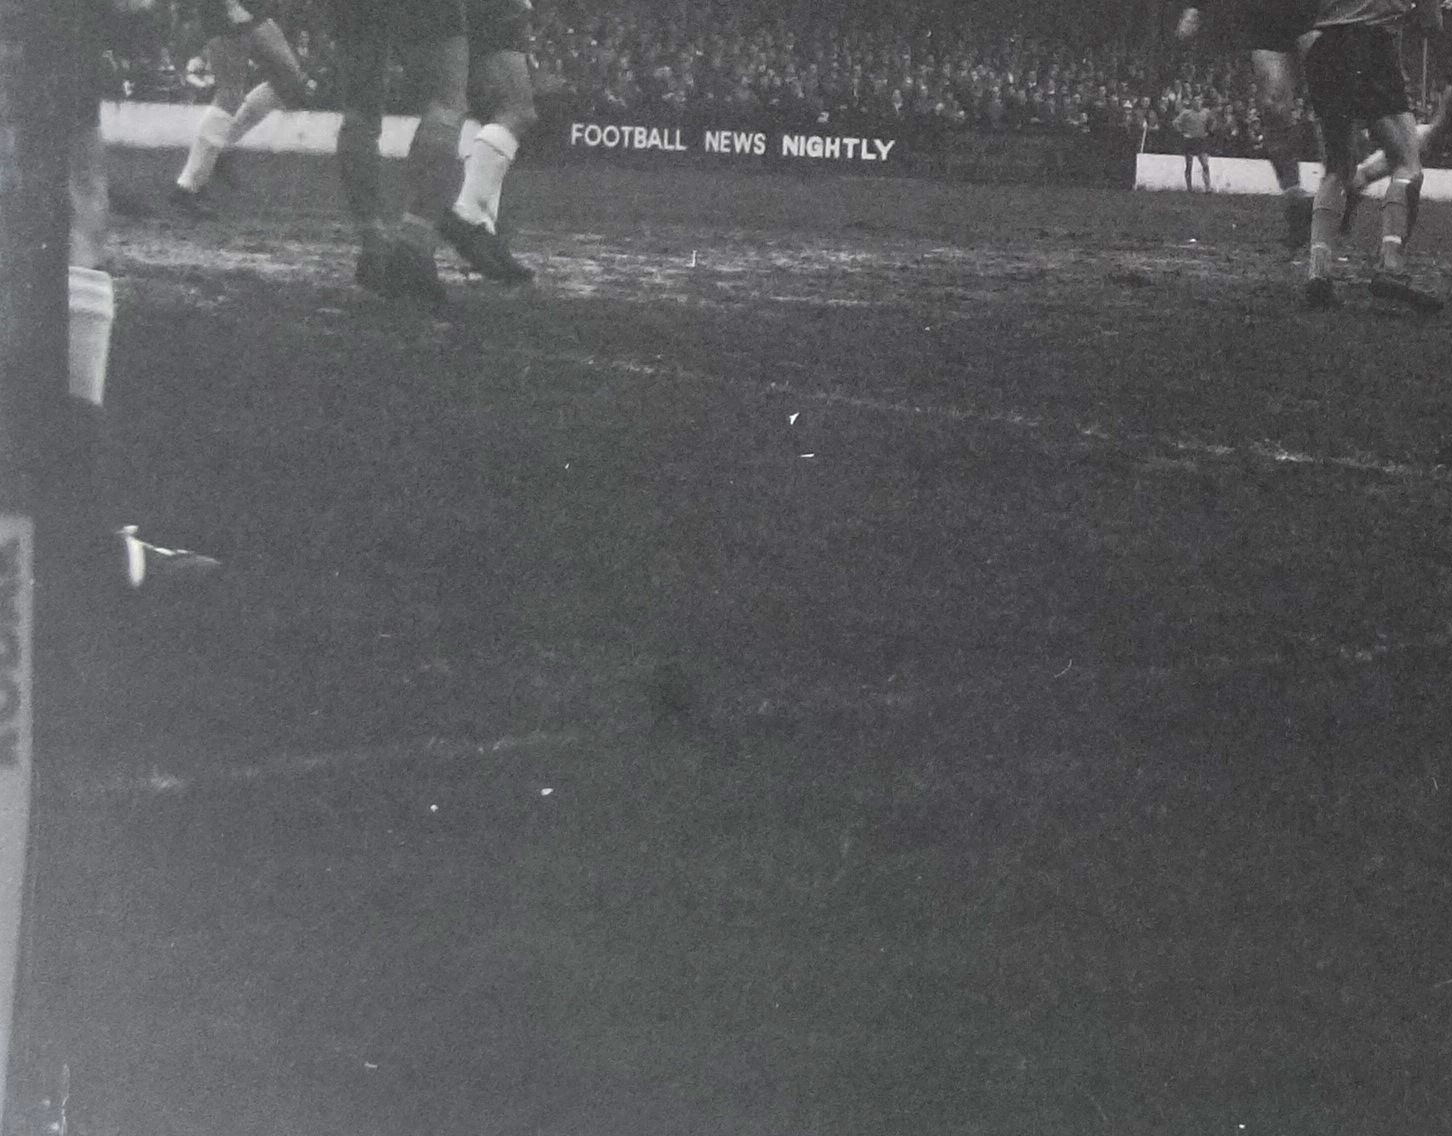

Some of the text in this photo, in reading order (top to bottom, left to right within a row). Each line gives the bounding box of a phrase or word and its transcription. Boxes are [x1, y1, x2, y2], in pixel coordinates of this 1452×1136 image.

[570, 123, 896, 161] FOOTBALL NEWS NIGHTLY
